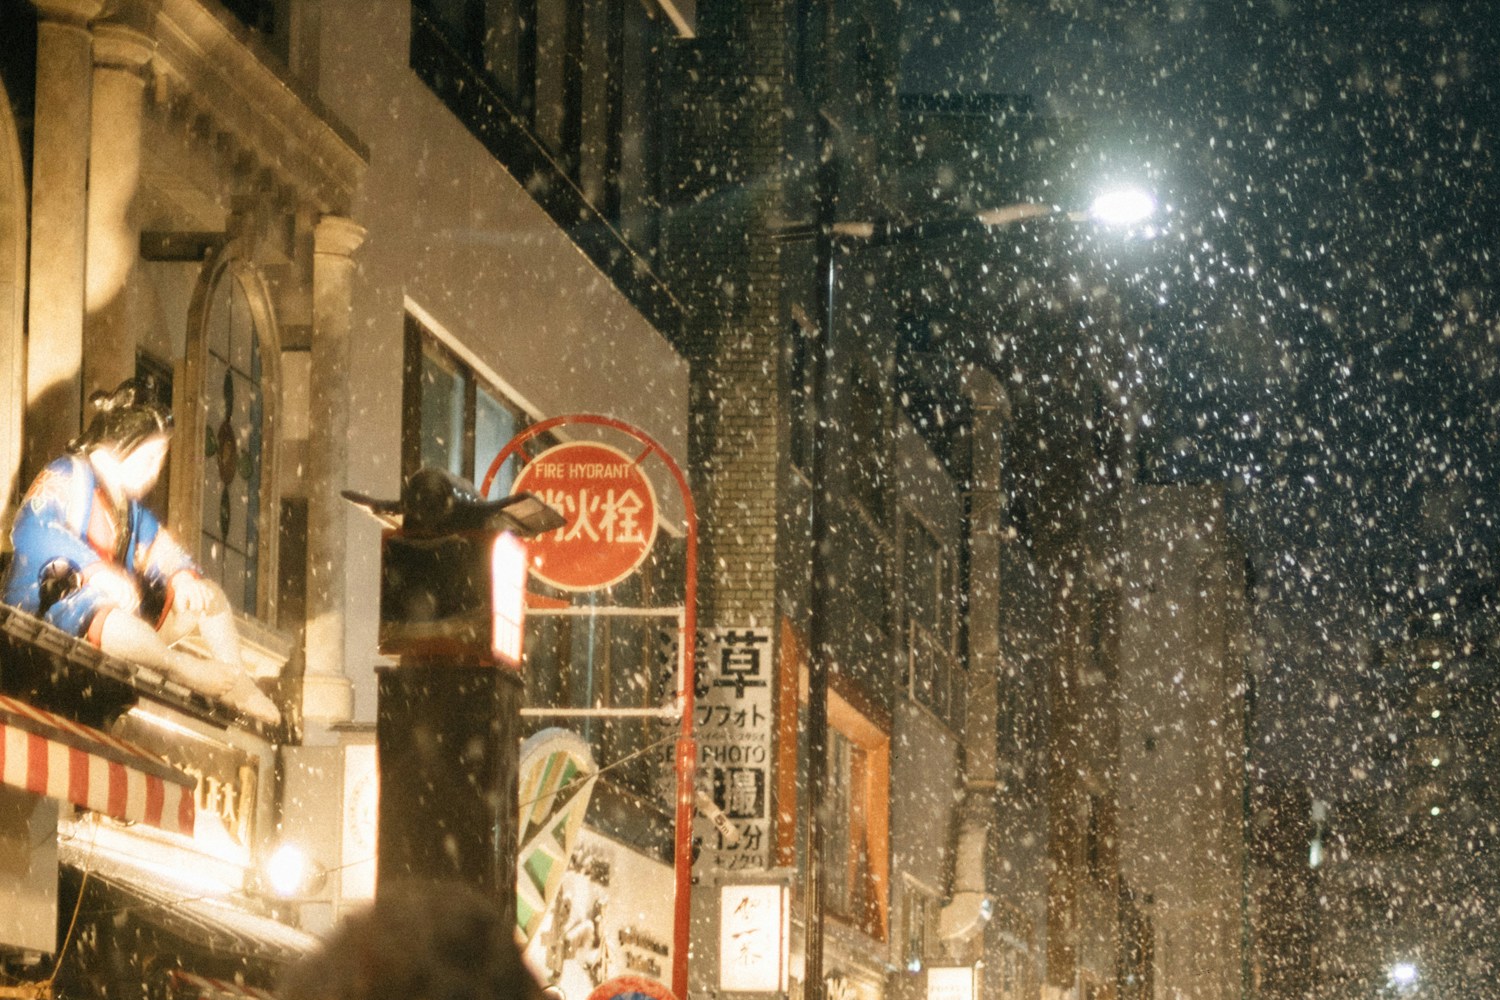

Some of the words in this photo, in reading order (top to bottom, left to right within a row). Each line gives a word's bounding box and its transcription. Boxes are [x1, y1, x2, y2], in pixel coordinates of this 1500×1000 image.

[535, 462, 564, 478] FIRE
[569, 462, 631, 478] HYDRANT
[701, 744, 766, 764] PHOTO
